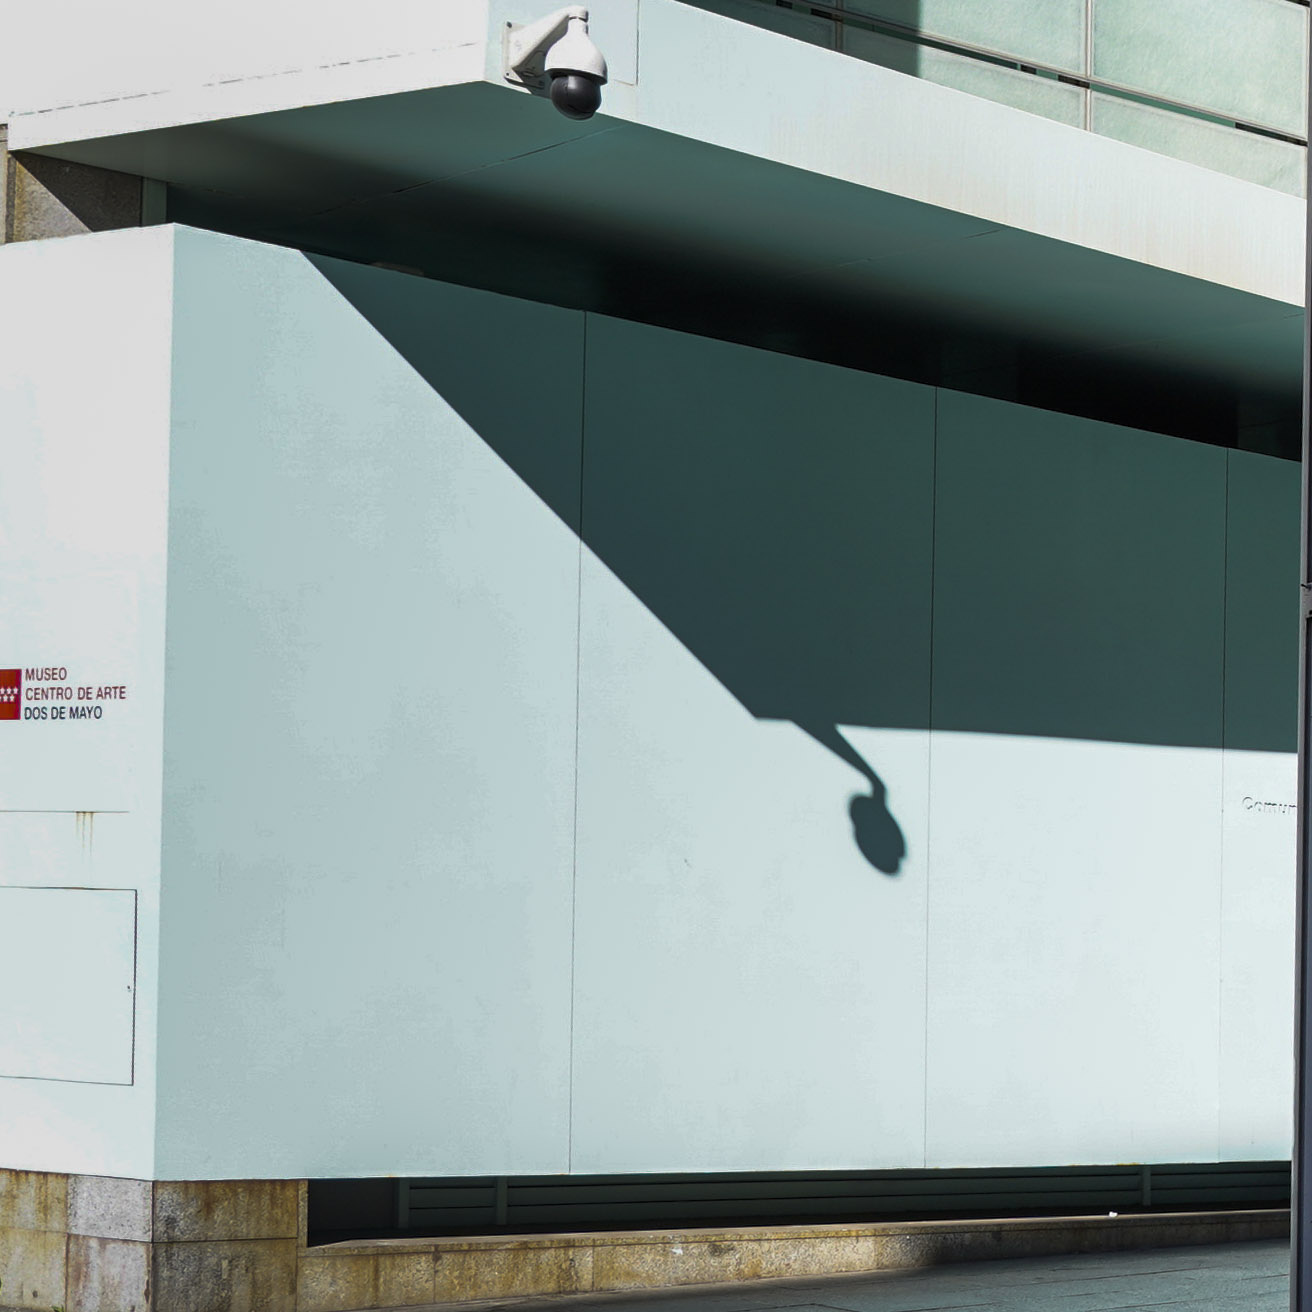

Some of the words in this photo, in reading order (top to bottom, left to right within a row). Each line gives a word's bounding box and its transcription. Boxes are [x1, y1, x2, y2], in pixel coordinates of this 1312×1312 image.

[25, 667, 68, 682] MUSEO
[25, 686, 73, 701] CENTRO
[77, 686, 94, 701] DE
[96, 685, 127, 700] ARTE
[24, 706, 48, 720] DOS
[51, 706, 66, 720] DE
[69, 705, 103, 720] MAYO
[1242, 796, 1297, 815] Comun
